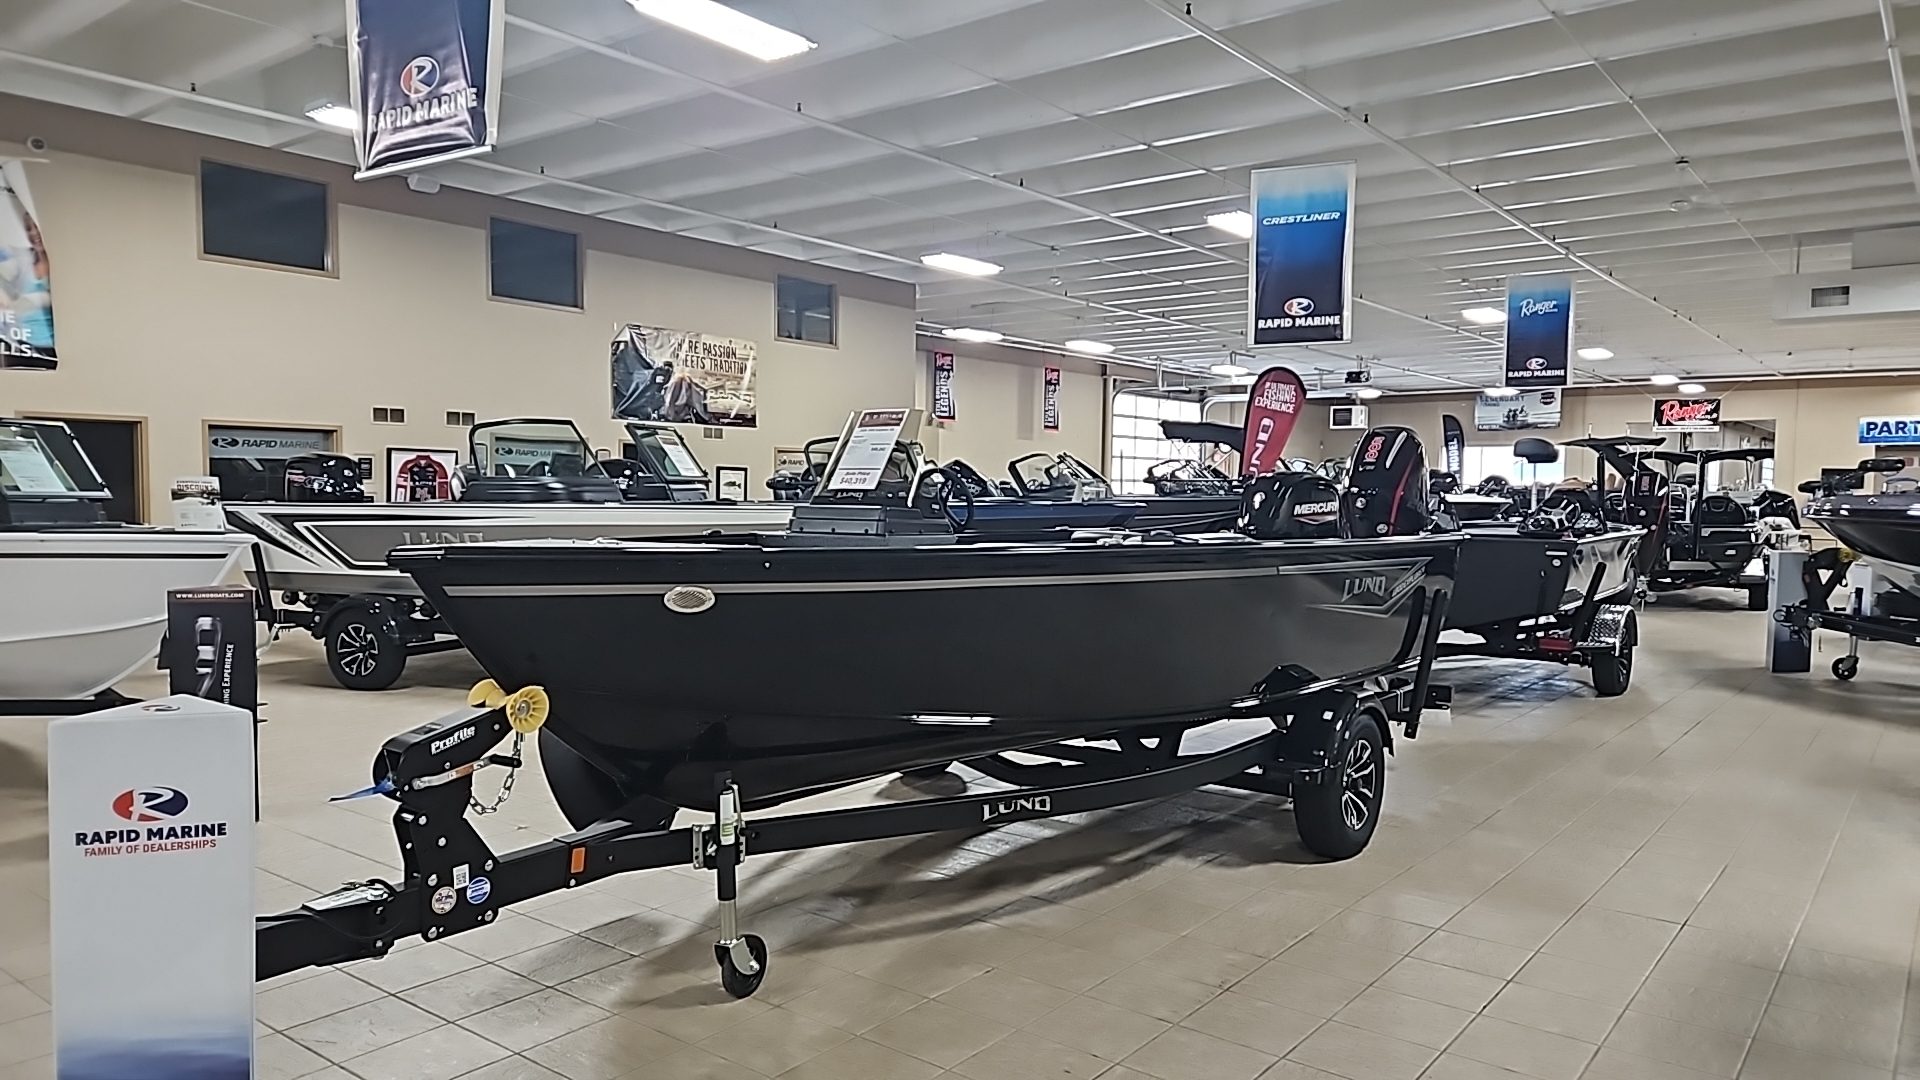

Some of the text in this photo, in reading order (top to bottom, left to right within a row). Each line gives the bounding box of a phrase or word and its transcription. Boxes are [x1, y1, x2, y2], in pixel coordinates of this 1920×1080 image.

[368, 87, 478, 132] RAPID MARINE
[1262, 211, 1341, 226] CRESTLINER
[1520, 298, 1557, 318] Ranger
[1258, 315, 1341, 329] RAPID MARINE
[10, 327, 32, 341] OF
[676, 338, 737, 360] HRE PASSION
[676, 352, 706, 370] EETS
[1507, 369, 1565, 378] RAPID MARINE
[939, 370, 950, 417] LEGENDS
[1263, 388, 1296, 403] FISHING
[1047, 384, 1055, 427] LEGENDS
[1254, 396, 1296, 414] EXPERIENCE
[1865, 420, 1920, 436] PART
[241, 439, 320, 449] RAPID MARINE
[514, 449, 539, 457] RAPID
[1447, 437, 1460, 472] MODEL
[1293, 501, 1338, 516] MERCUR
[1341, 576, 1386, 602] LUND
[221, 643, 235, 687] EXPERIENCE
[431, 725, 476, 754] Profile
[982, 795, 1051, 822] LUND
[75, 822, 227, 846] RAPID MARINE
[84, 839, 217, 857] FAMILY OF DEALERSHIPS
